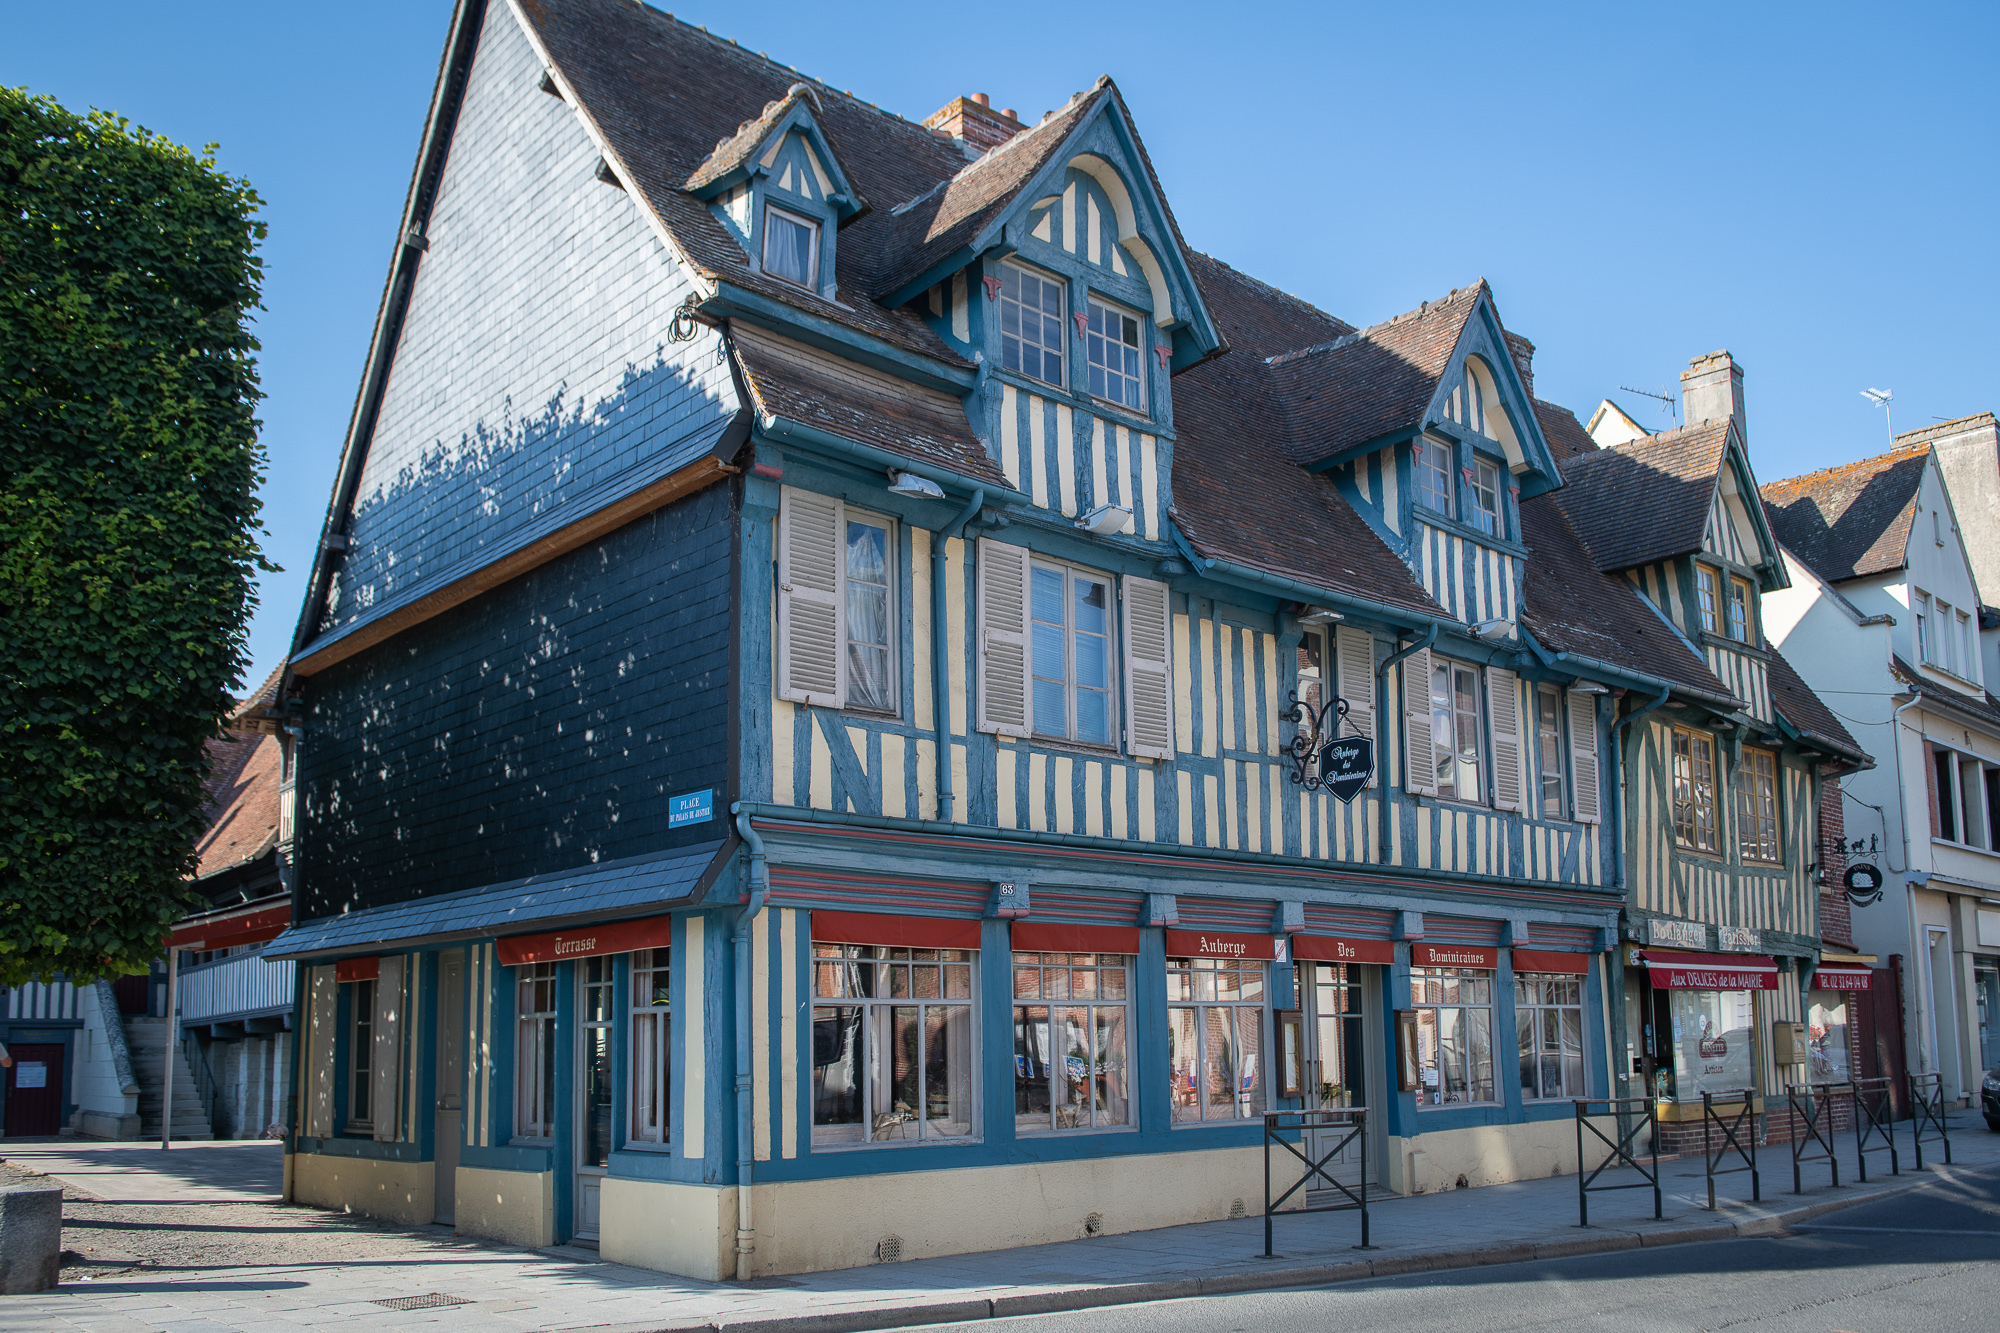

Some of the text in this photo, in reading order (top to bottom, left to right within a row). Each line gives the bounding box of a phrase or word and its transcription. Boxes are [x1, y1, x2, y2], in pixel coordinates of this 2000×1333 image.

[1331, 746, 1360, 760] Auberge
[680, 797, 700, 810] PLACE
[675, 811, 689, 822] PALAIS
[689, 810, 695, 819] DE
[695, 806, 710, 818] JUSTICE
[1002, 885, 1013, 894] 63
[1652, 920, 1703, 947] Boulanger
[555, 937, 597, 955] Terrasse
[1199, 936, 1246, 957] Auberge
[1337, 942, 1355, 957] Des
[1429, 948, 1485, 964] Dominicaines
[1670, 971, 1763, 988] Aux DELICES de la MAIRIE
[1830, 976, 1838, 988] 02
[1846, 976, 1853, 989] 64
